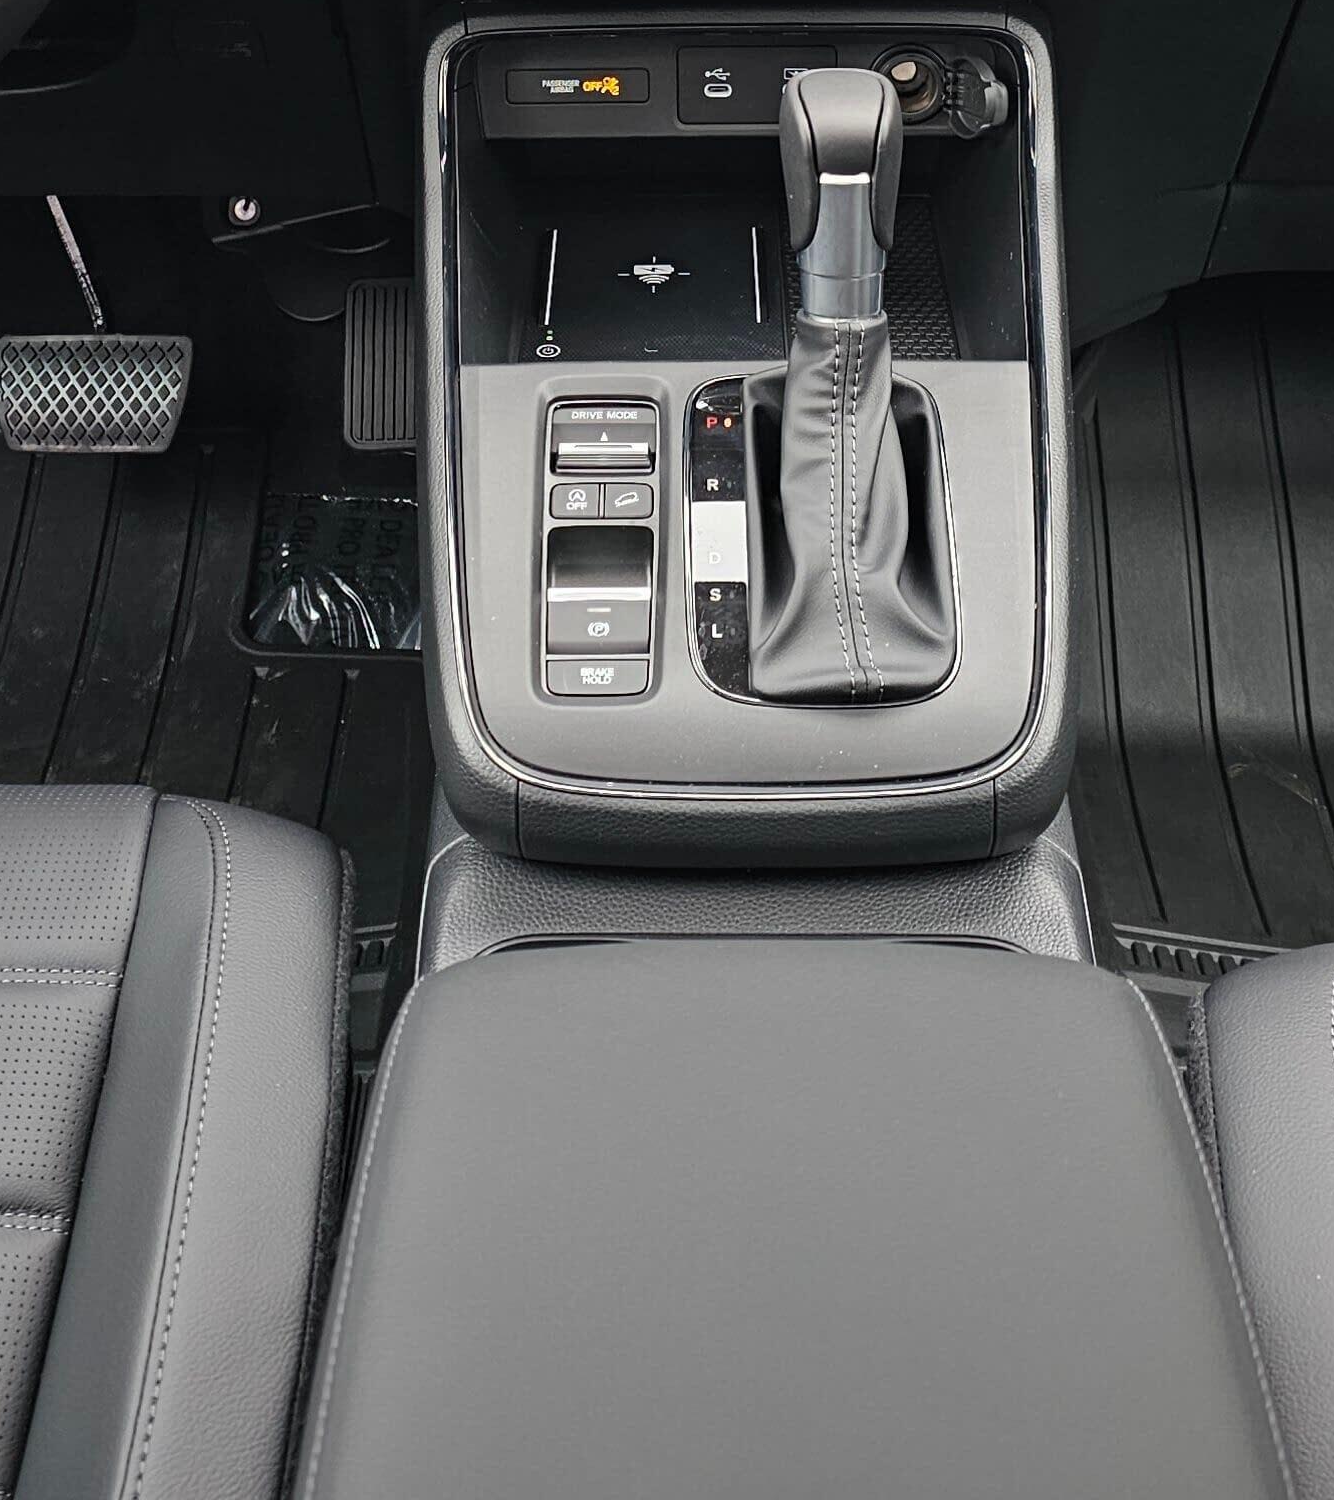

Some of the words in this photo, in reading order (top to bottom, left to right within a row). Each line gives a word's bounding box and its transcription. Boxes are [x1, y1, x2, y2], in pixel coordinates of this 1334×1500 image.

[583, 81, 603, 92] OFF
[571, 410, 604, 421] DRIVE
[607, 410, 638, 420] MODE
[706, 417, 718, 429] P
[706, 478, 719, 492] R
[566, 501, 588, 511] OFF
[709, 552, 722, 565] D
[709, 588, 722, 602] S
[712, 624, 723, 638] L
[580, 667, 614, 677] BRAKE
[582, 675, 611, 685] HOLD
